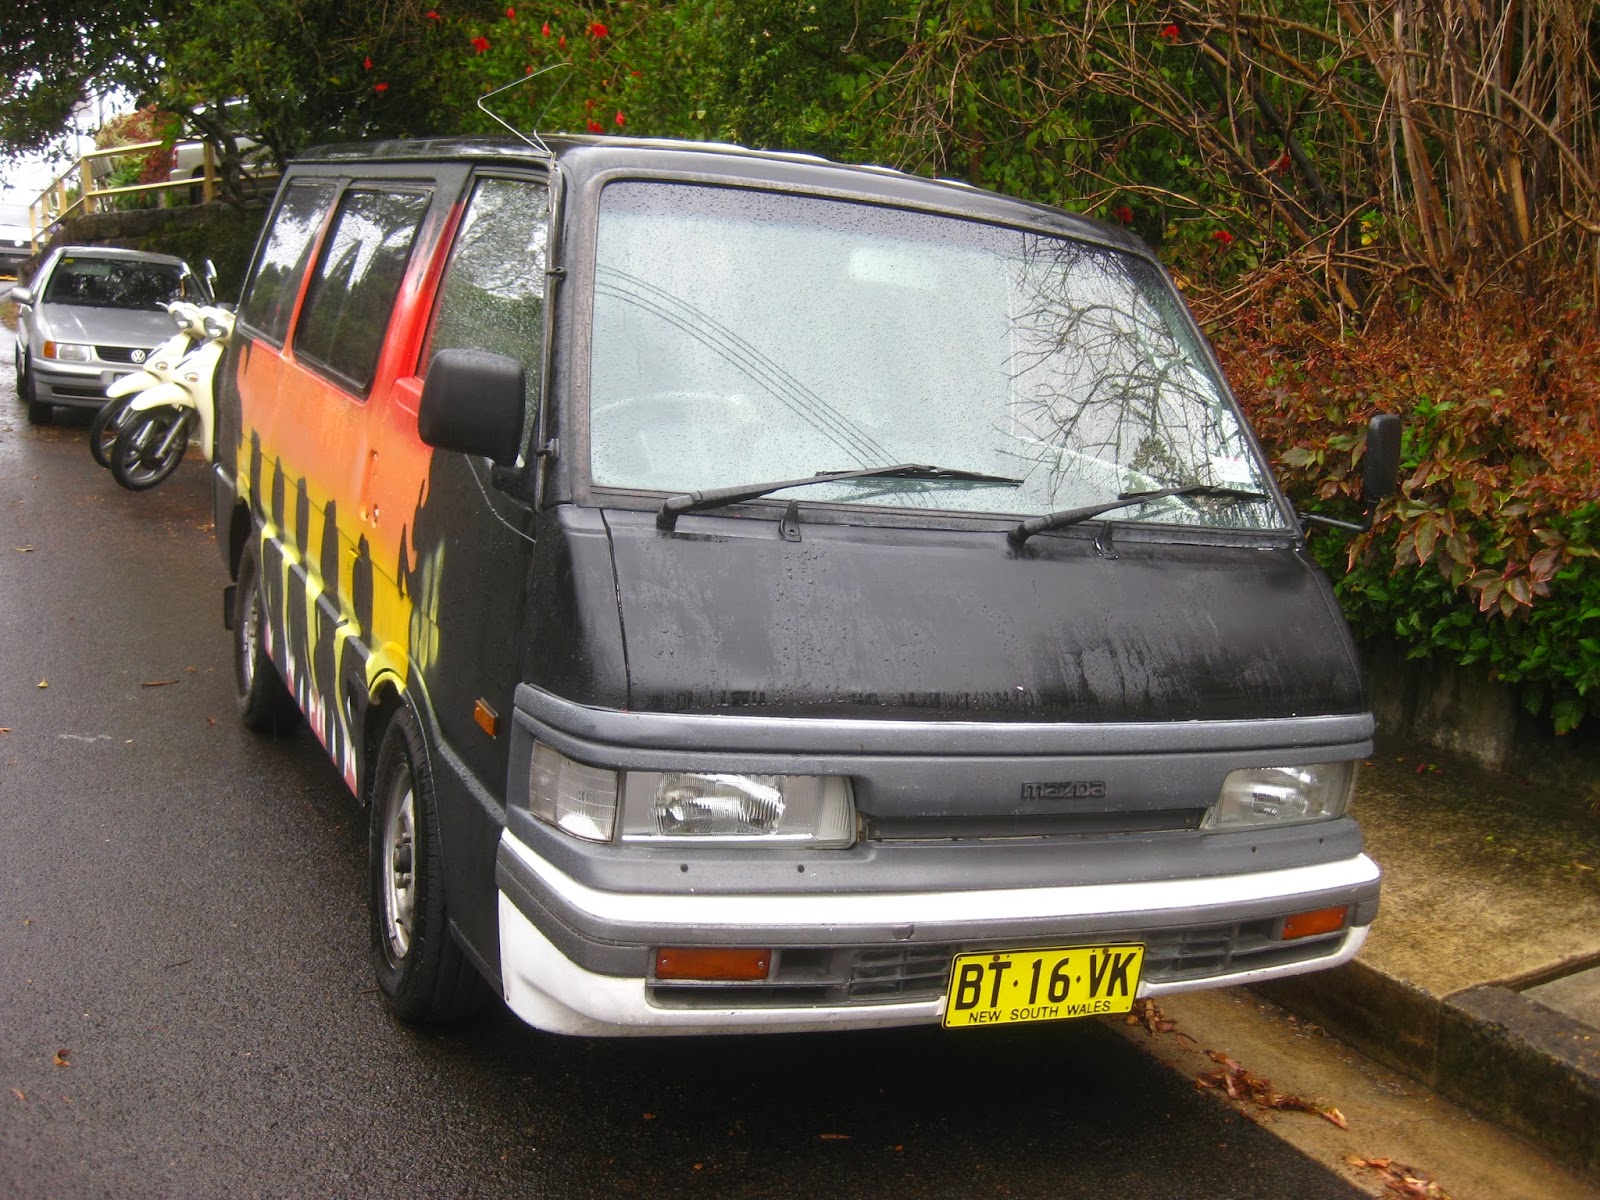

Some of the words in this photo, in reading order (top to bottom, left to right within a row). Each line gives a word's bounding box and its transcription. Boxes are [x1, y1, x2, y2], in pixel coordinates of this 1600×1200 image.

[968, 1010, 1002, 1024] NEW
[1010, 1004, 1059, 1021] SOUTH
[1066, 1000, 1111, 1015] WALES
